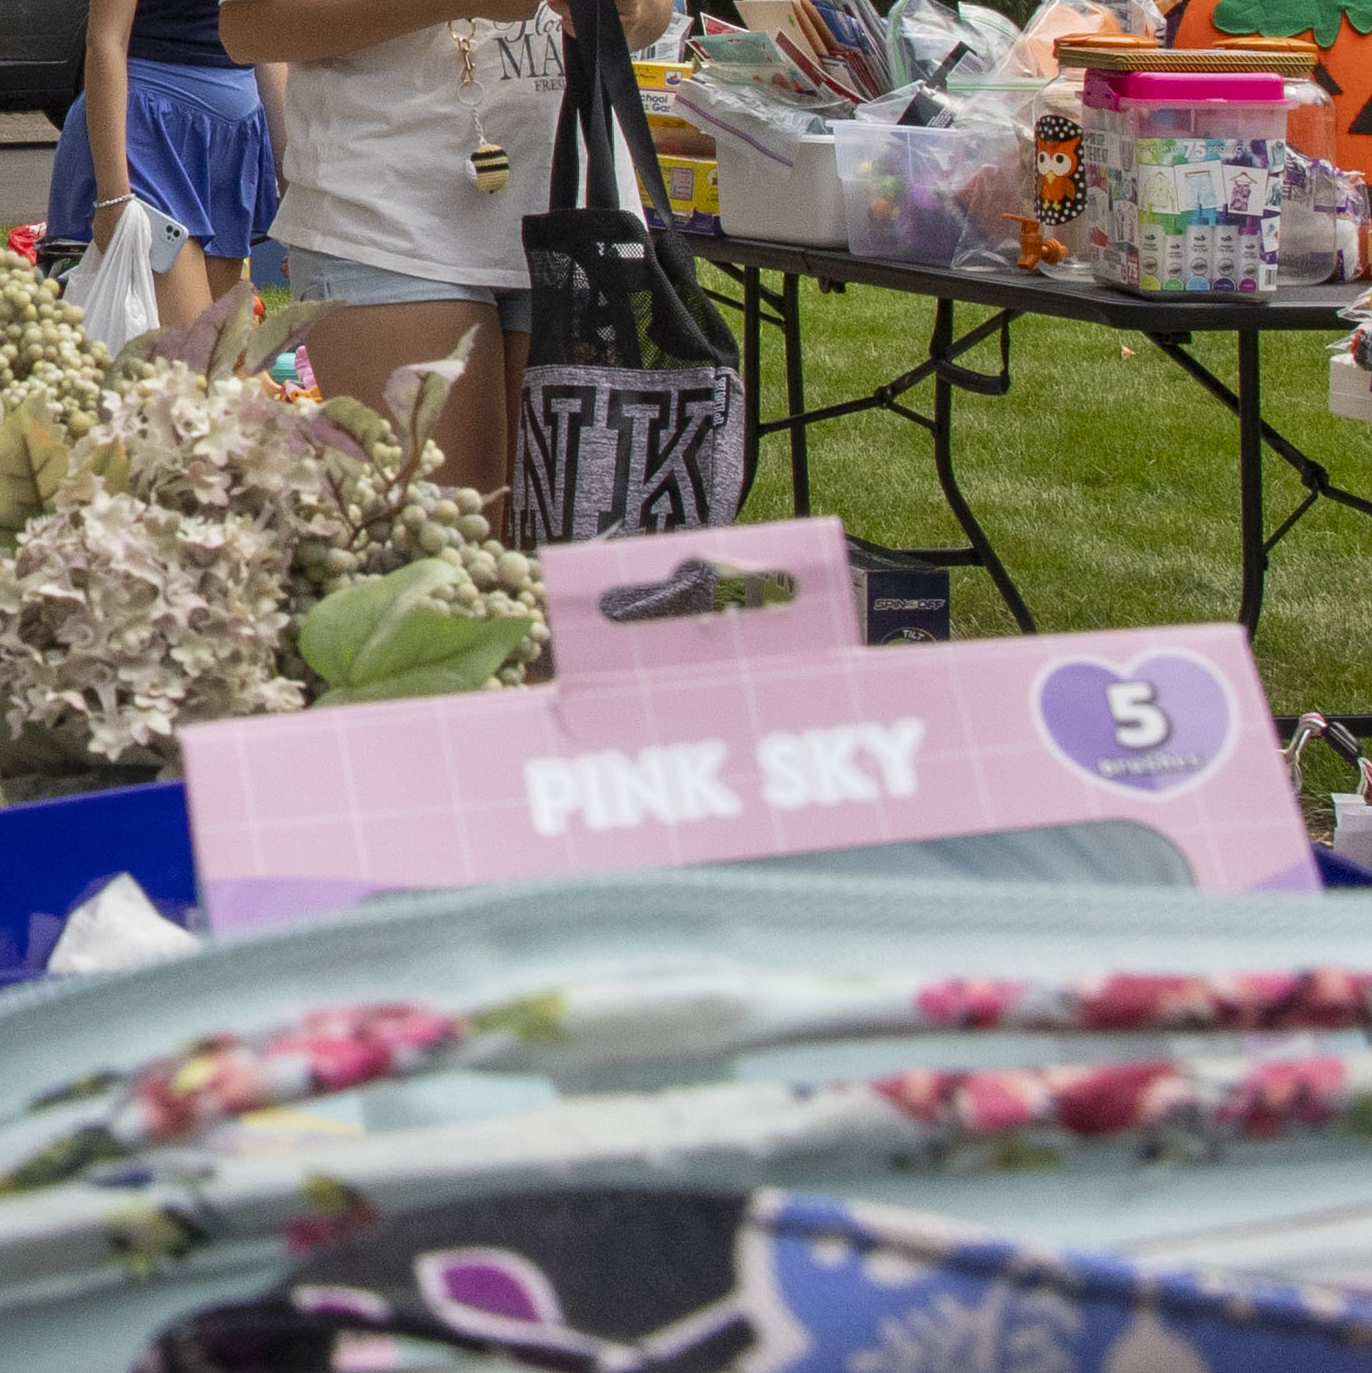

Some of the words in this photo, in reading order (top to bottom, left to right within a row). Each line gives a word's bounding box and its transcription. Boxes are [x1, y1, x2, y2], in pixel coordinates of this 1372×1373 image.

[1184, 140, 1207, 158] 75
[712, 375, 728, 427] PINK
[902, 629, 925, 641] TILT
[1106, 681, 1172, 751] 5
[524, 739, 744, 835] PINK
[757, 716, 926, 810] SKY
